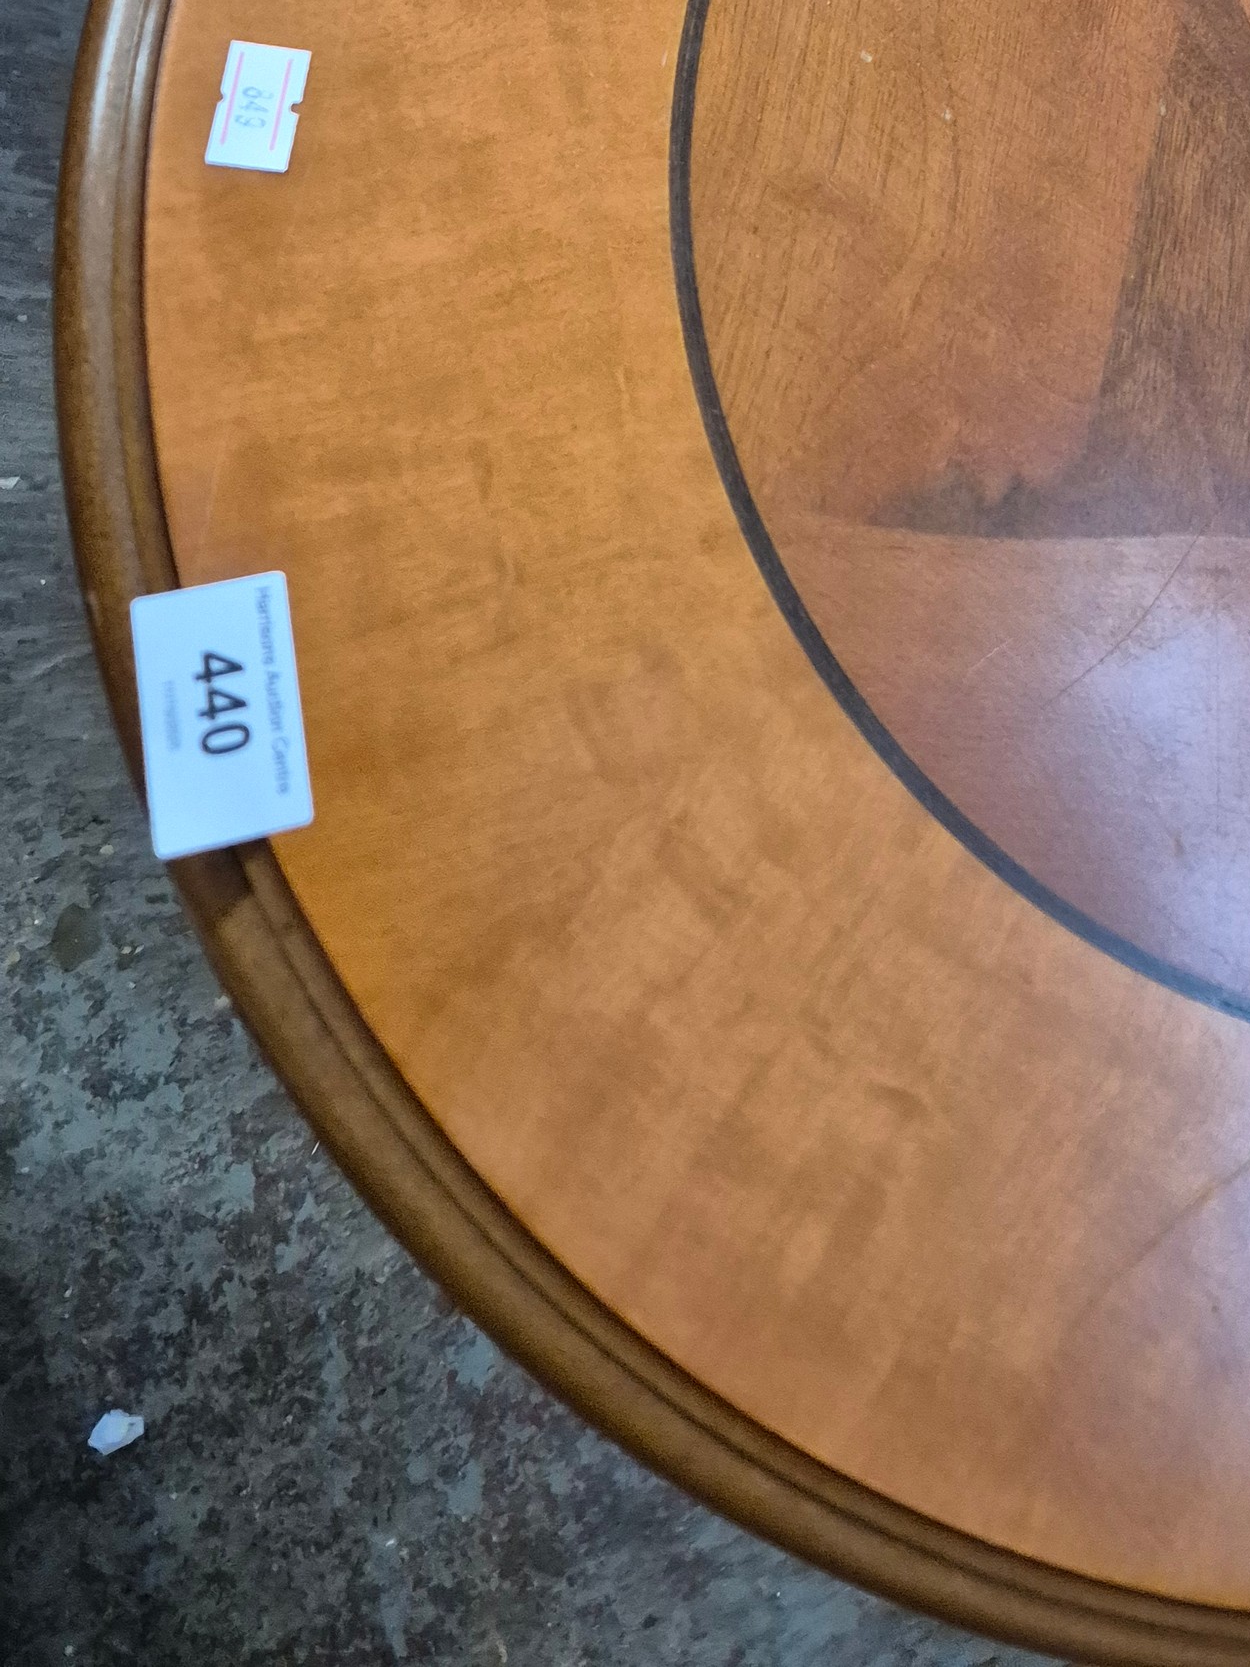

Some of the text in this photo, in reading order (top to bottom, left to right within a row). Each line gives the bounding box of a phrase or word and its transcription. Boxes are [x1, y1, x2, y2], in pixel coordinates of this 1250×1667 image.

[193, 650, 251, 755] 440
[265, 670, 283, 732] Auction
[271, 737, 290, 795] Centre
